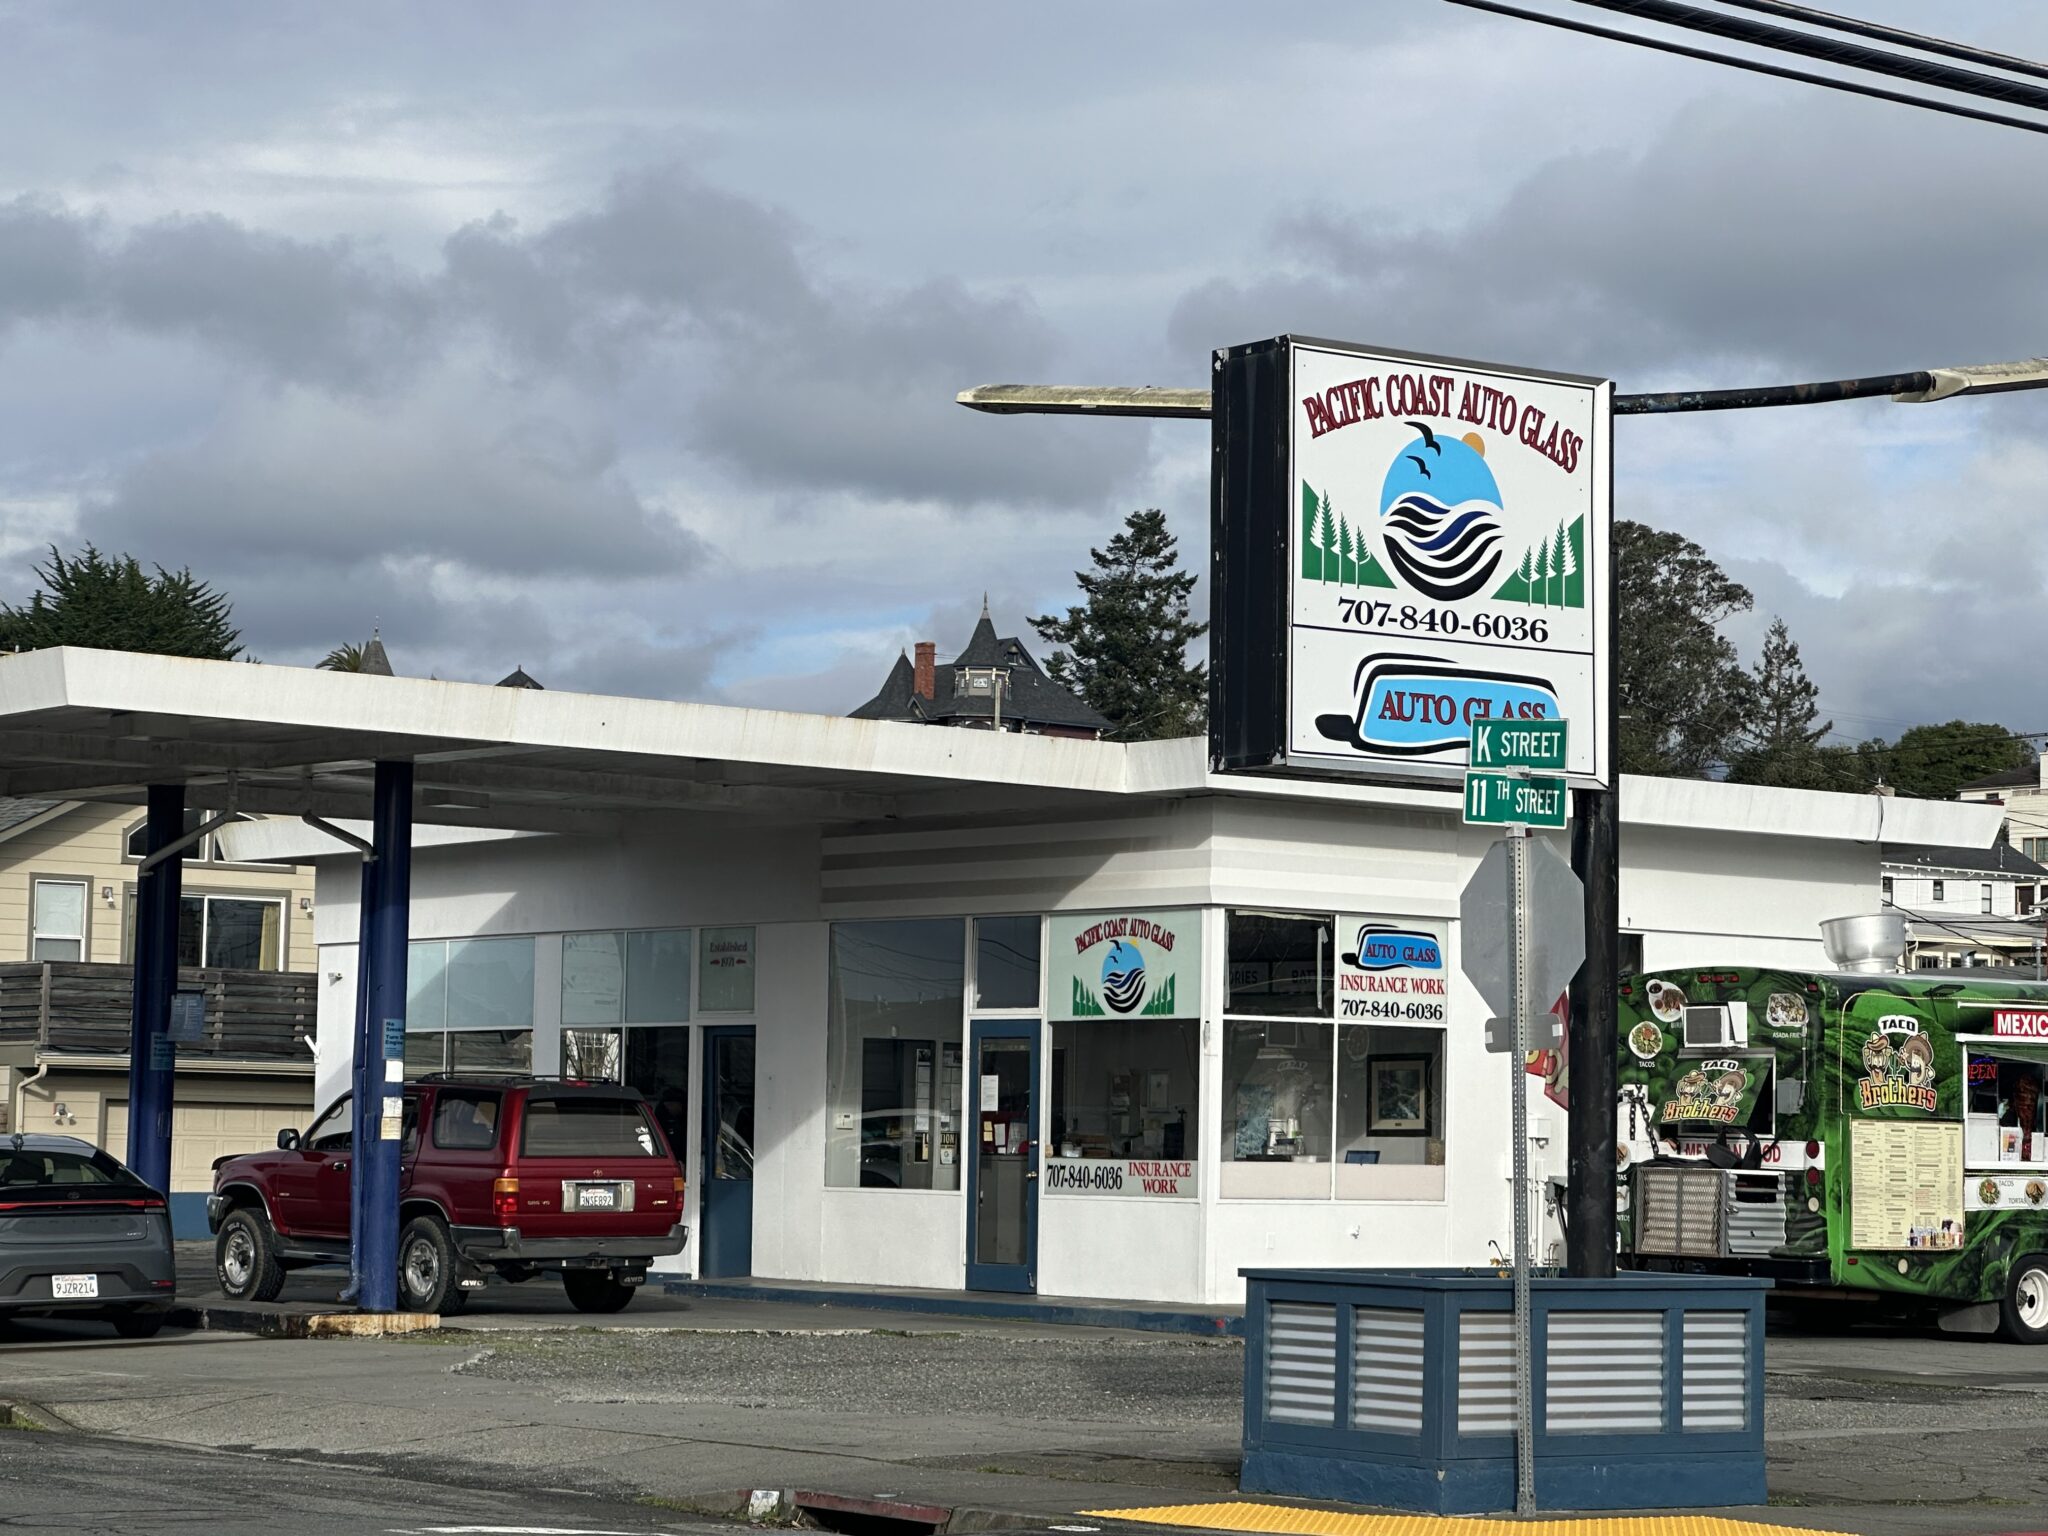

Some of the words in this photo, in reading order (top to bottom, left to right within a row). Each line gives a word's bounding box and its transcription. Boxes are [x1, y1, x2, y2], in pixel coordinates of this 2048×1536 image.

[1302, 376, 1385, 439] PACIFIC
[1386, 374, 1455, 417] COAST
[1458, 380, 1517, 435] AUTO
[1519, 405, 1584, 474] GLASS
[1337, 596, 1549, 643] 707-840-6036
[1378, 690, 1457, 726] AUTO
[1477, 726, 1492, 763] K
[1500, 731, 1561, 759] STREET
[1471, 778, 1487, 817] 11
[1496, 780, 1510, 800] TH
[1515, 787, 1560, 816] STREET
[710, 941, 747, 952] Established
[1075, 923, 1103, 955] PACIFIC
[1103, 917, 1128, 940] COAST
[1129, 917, 1151, 940] AUTO
[1151, 924, 1175, 952] GLASS
[1365, 943, 1397, 959] AUTO
[1402, 946, 1436, 963] GLASS
[1340, 974, 1408, 993] INSURANCE
[1411, 978, 1445, 995] WORK
[1341, 998, 1443, 1020] 707-840-6036
[1881, 1019, 1916, 1032] TACO
[1997, 1013, 2048, 1036] MEXIC
[1702, 1060, 1738, 1070] TACO
[1860, 1075, 1936, 1111] Brothers
[1663, 1099, 1739, 1122] Brothers
[1046, 1164, 1123, 1190] 707-840-6036
[1128, 1162, 1191, 1178] INSURANCE
[1142, 1179, 1179, 1194] WORK
[56, 1282, 95, 1294] 9JZR214
[461, 1279, 484, 1287] 4WD
